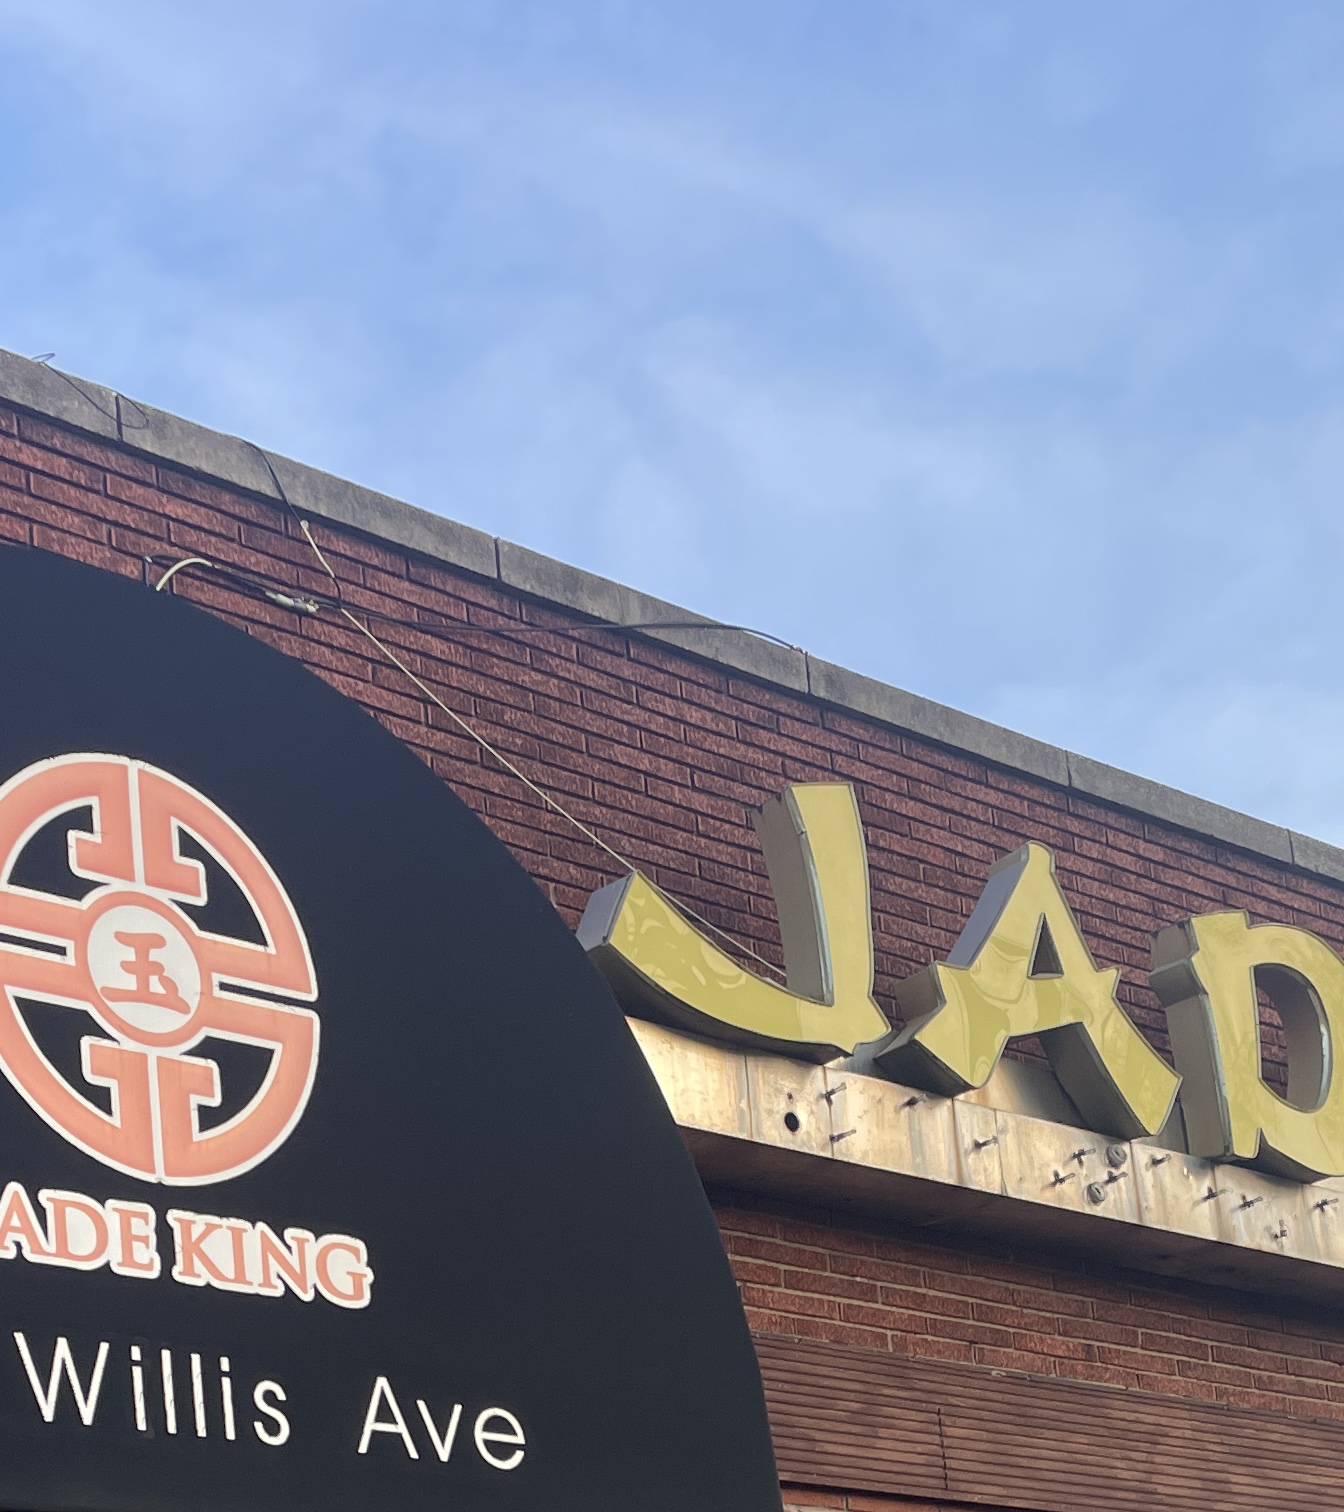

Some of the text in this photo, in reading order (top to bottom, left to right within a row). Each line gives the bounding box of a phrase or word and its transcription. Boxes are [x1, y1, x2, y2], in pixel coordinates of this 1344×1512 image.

[100, 930, 191, 1015] 玉
[166, 1209, 374, 1309] KING
[14, 1331, 291, 1446] Willis
[357, 1376, 527, 1470] Ave
